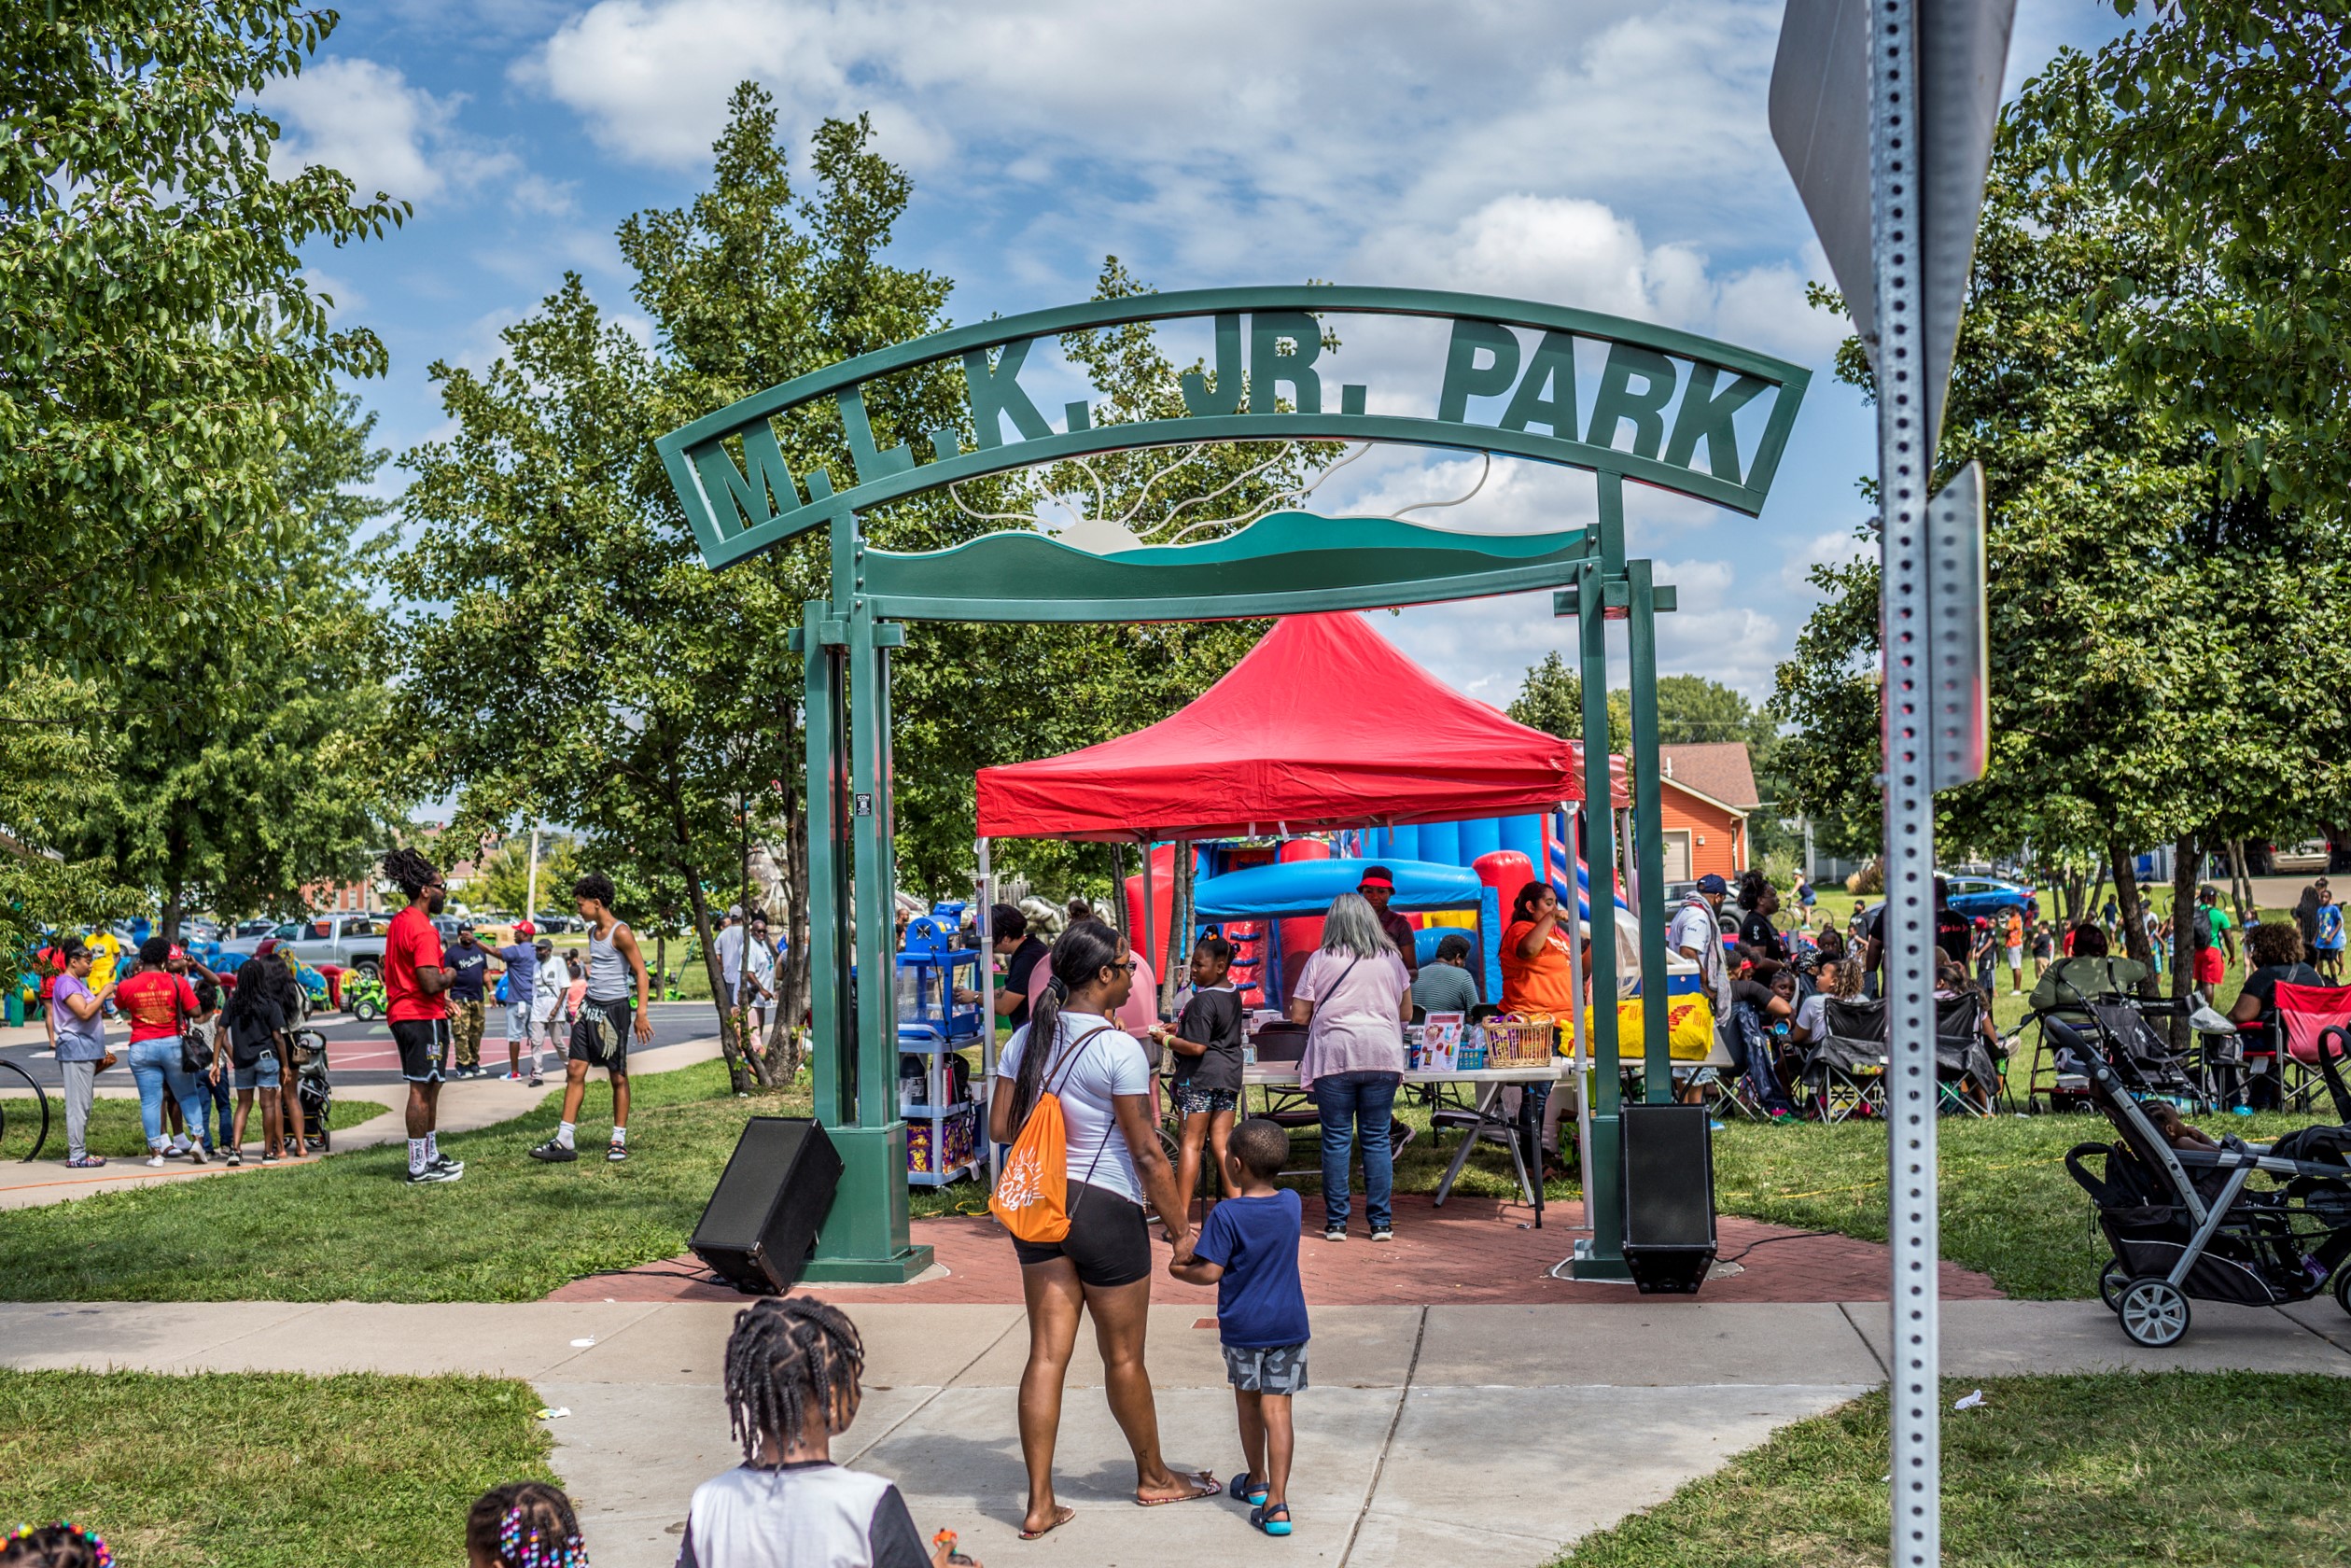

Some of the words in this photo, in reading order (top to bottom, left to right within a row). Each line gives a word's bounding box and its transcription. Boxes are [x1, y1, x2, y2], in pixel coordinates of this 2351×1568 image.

[689, 338, 1091, 539] M.L.K.
[1181, 312, 1367, 416] JR.
[1438, 317, 1771, 486] PARK
